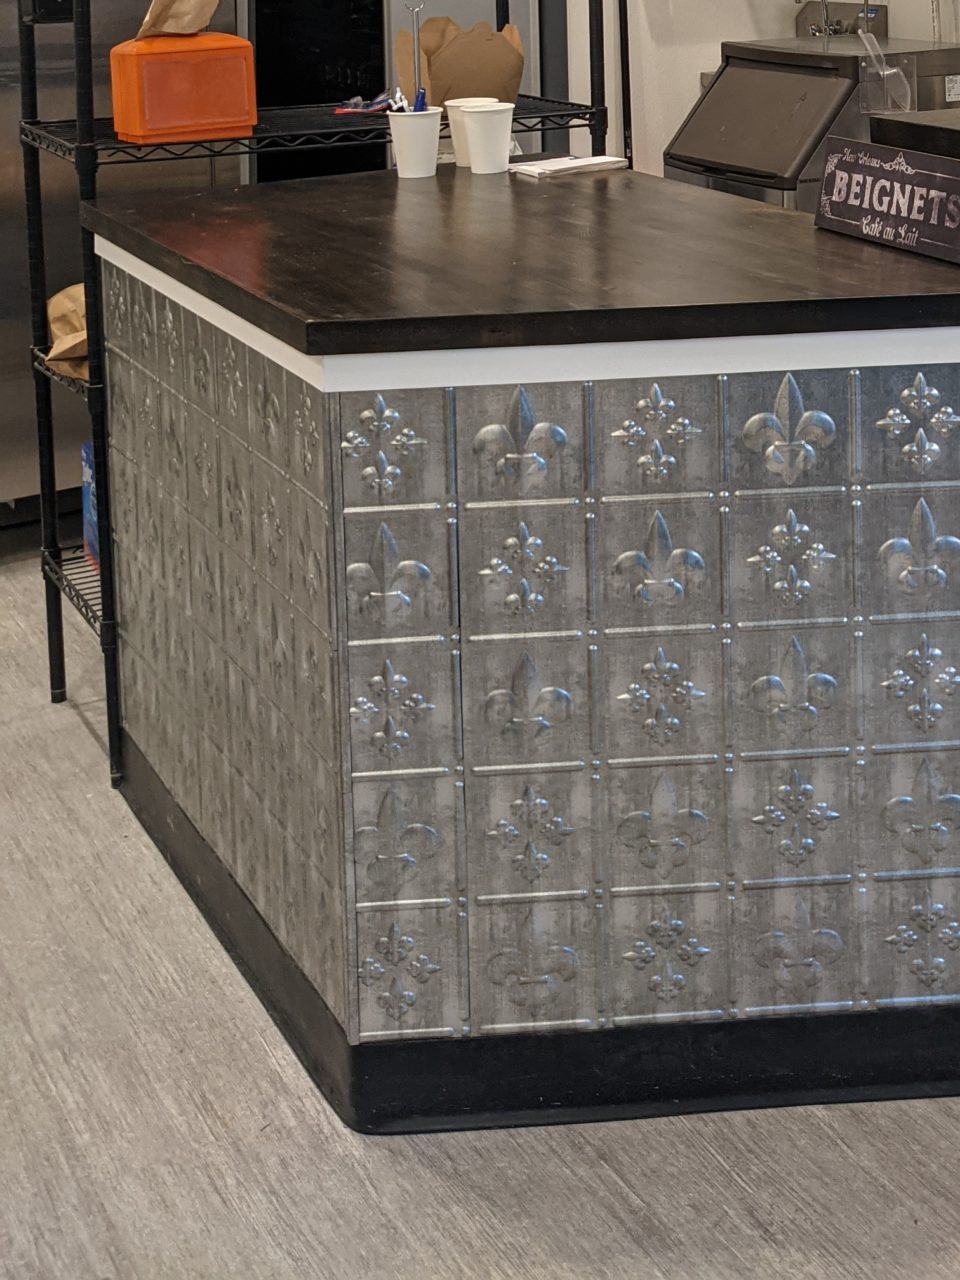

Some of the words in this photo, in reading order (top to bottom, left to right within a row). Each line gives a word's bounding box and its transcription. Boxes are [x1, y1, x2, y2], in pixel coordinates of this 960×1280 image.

[862, 214, 882, 236] Café
[883, 225, 895, 241] au
[896, 224, 919, 247] Lait
